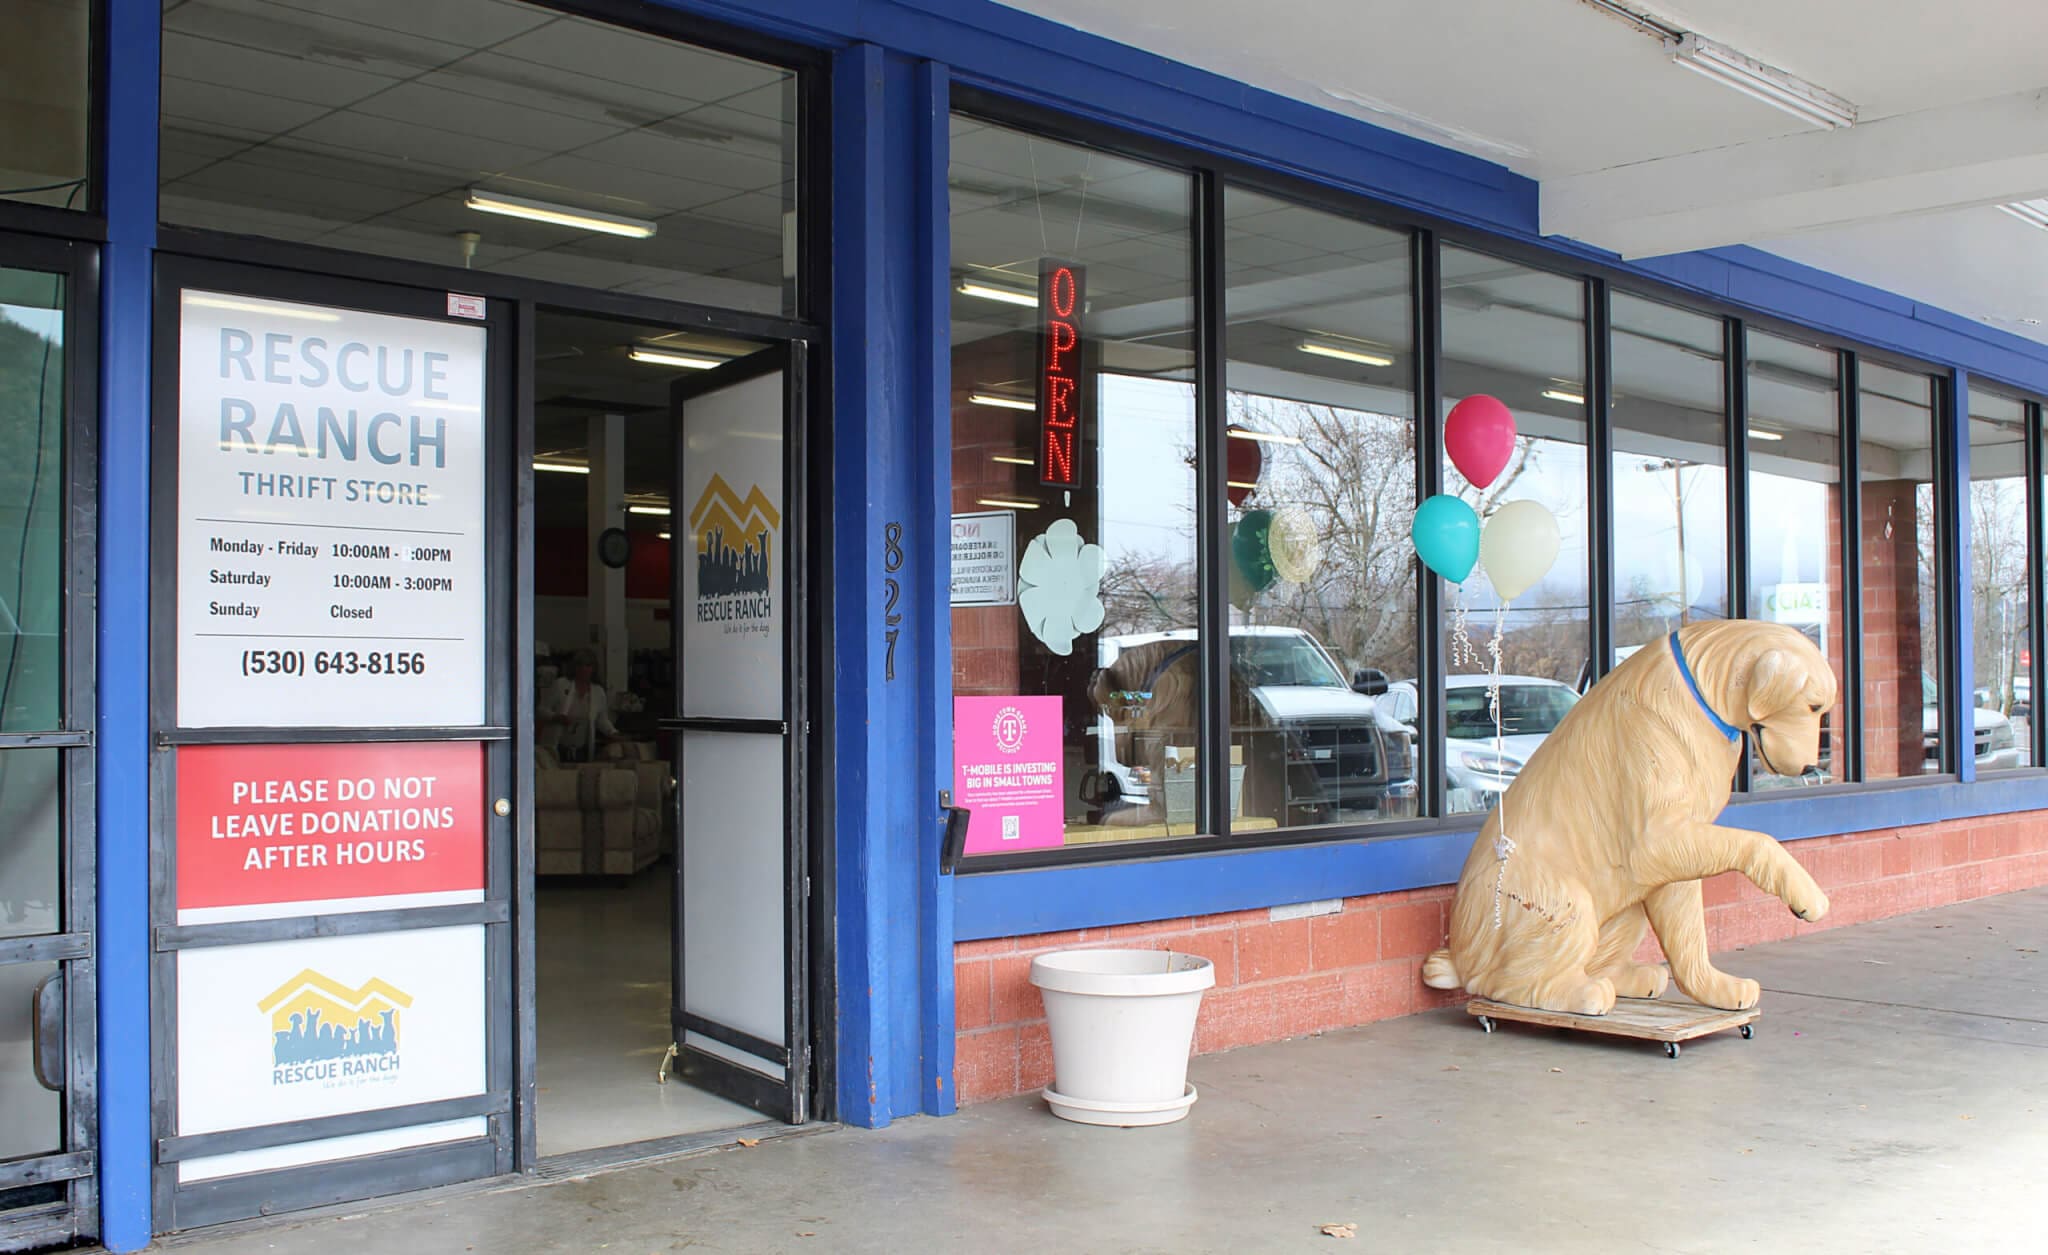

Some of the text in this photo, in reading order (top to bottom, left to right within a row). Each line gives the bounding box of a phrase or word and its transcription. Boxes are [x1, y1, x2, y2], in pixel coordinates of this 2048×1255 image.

[219, 327, 449, 400] RESCUE
[1046, 268, 1076, 482] OPEN
[219, 398, 447, 468] RANCH
[238, 471, 428, 506] THRIFT STORE
[210, 538, 264, 555] Monday
[278, 541, 319, 559] Friday
[332, 543, 390, 560] 10:00AM
[209, 569, 271, 587] Saturday
[333, 574, 391, 590] 10:00AM
[404, 576, 452, 592] 3:00PM
[209, 601, 373, 619] Sunday Closed
[697, 598, 771, 623] RESCUE RANCH
[885, 521, 903, 683] 827
[242, 650, 425, 677] (530) 643-8156
[1003, 719, 1017, 741] T
[961, 762, 1057, 776] T-MOBILE IS INVESTING
[966, 774, 1053, 789] BIG IN SMALL TOWNS
[233, 776, 437, 805] PLEASE DO NOT
[211, 806, 454, 839] LEAVE DONATIONS
[243, 839, 426, 870] AFTER HOURS
[273, 1055, 400, 1085] RESCUE RANCH
